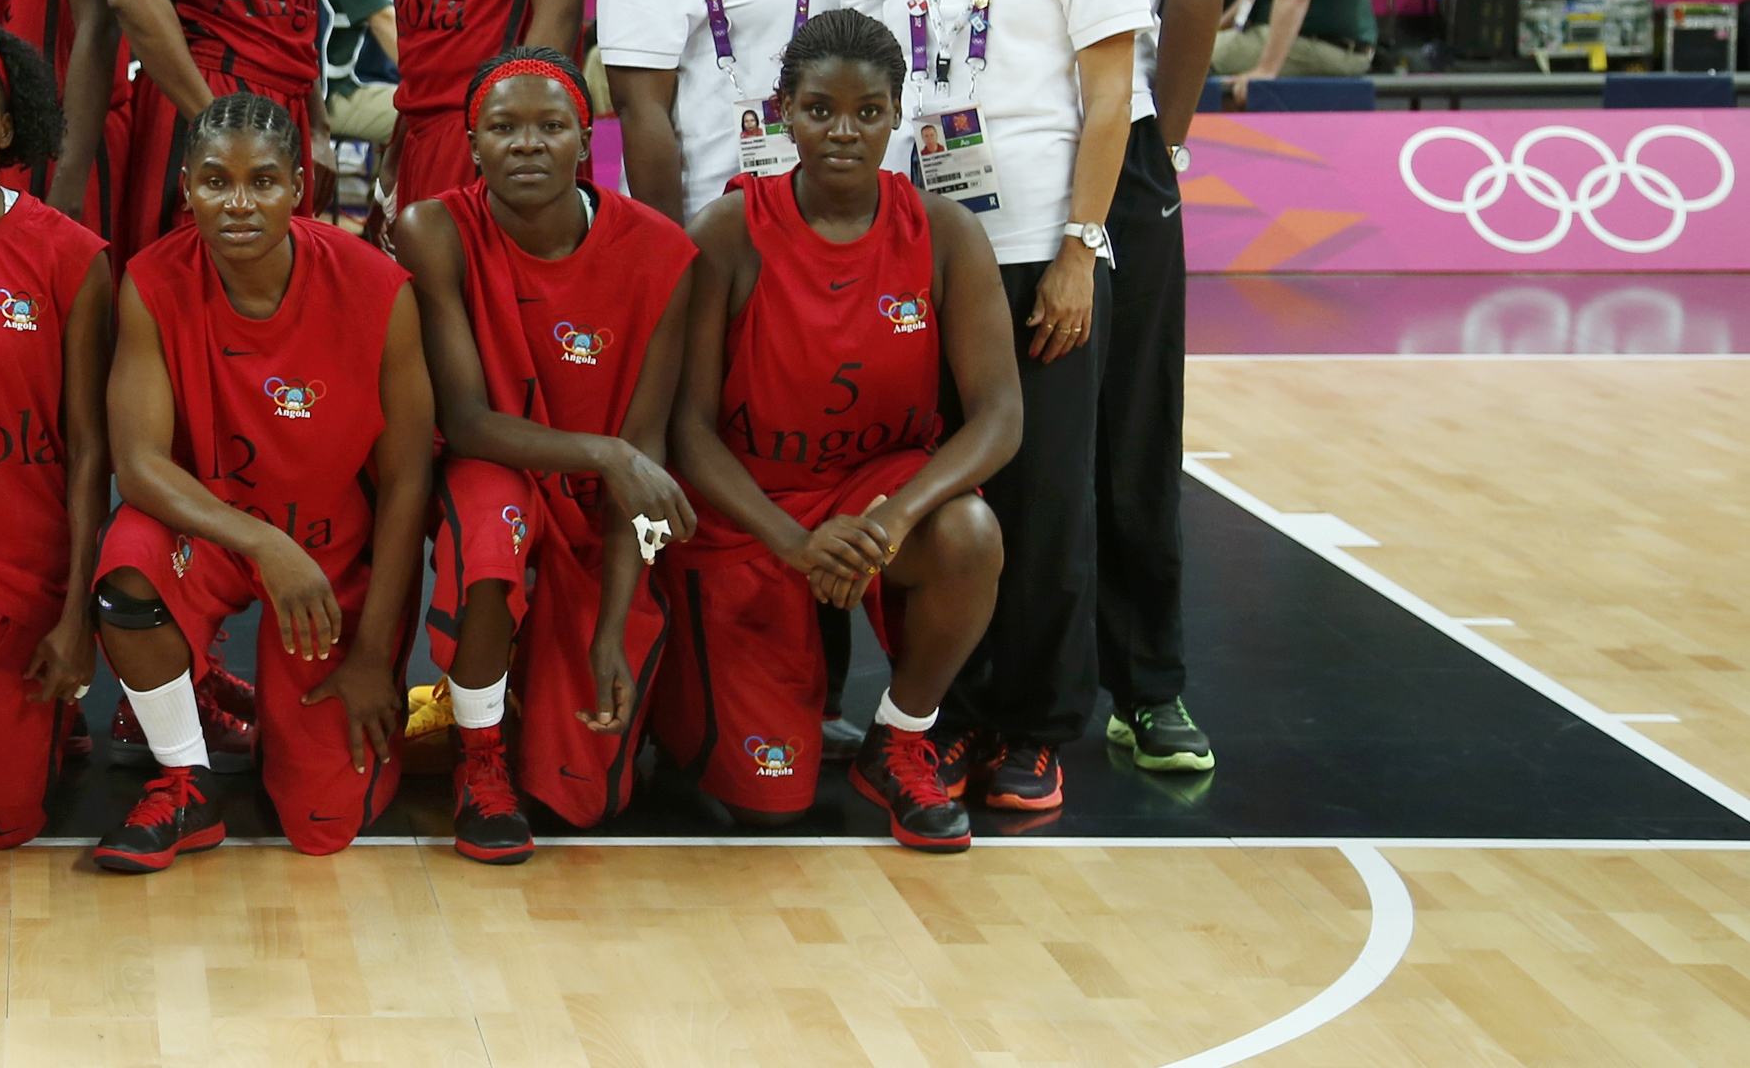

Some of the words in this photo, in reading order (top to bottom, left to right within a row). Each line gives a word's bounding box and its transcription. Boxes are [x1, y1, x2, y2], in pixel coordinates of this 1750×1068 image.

[988, 196, 997, 207] R
[2, 318, 38, 332] Angola
[893, 319, 927, 334] Angola
[561, 350, 598, 366] Angola
[823, 362, 863, 416] 5
[273, 406, 312, 420] Angola
[755, 766, 795, 779] Angola
